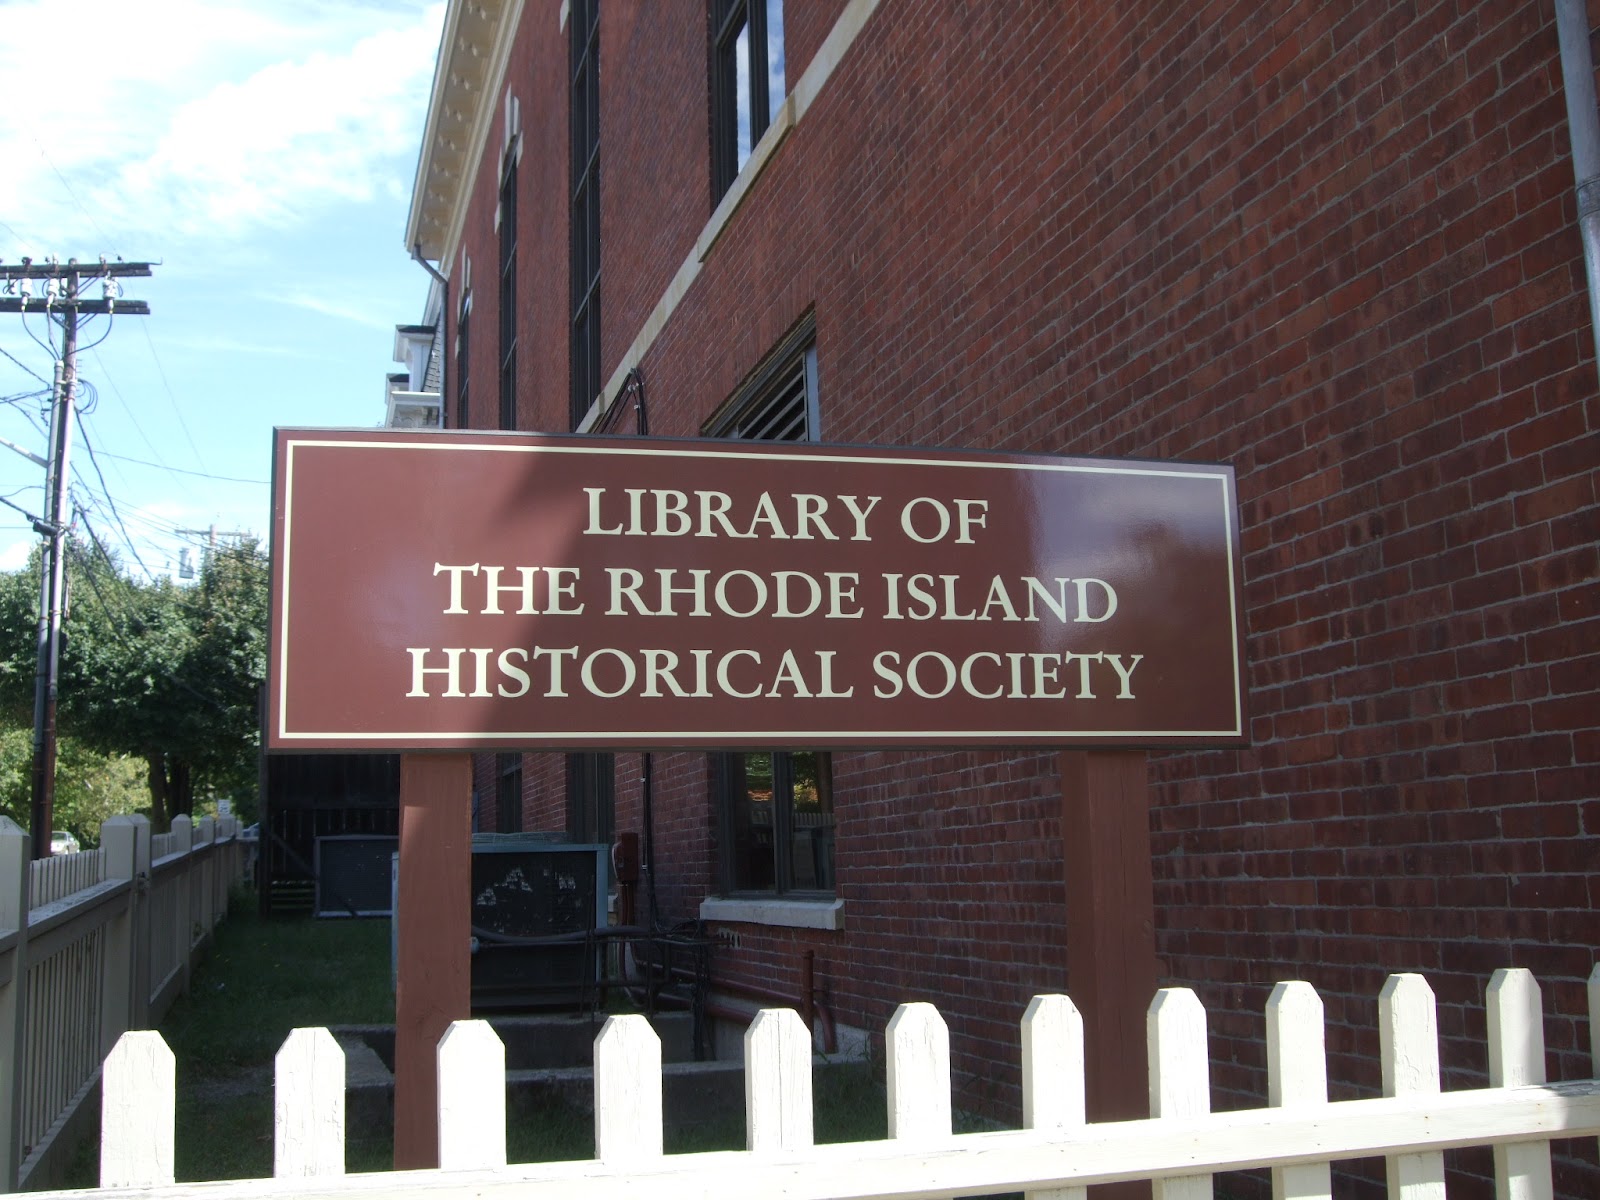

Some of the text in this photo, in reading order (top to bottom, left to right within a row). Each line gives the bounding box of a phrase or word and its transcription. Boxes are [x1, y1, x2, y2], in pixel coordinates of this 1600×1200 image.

[583, 488, 988, 543] LIBRARY OF
[433, 562, 1117, 623] THE RHODE ISLAND
[406, 646, 1143, 698] HISTORICAL SOCIETY
